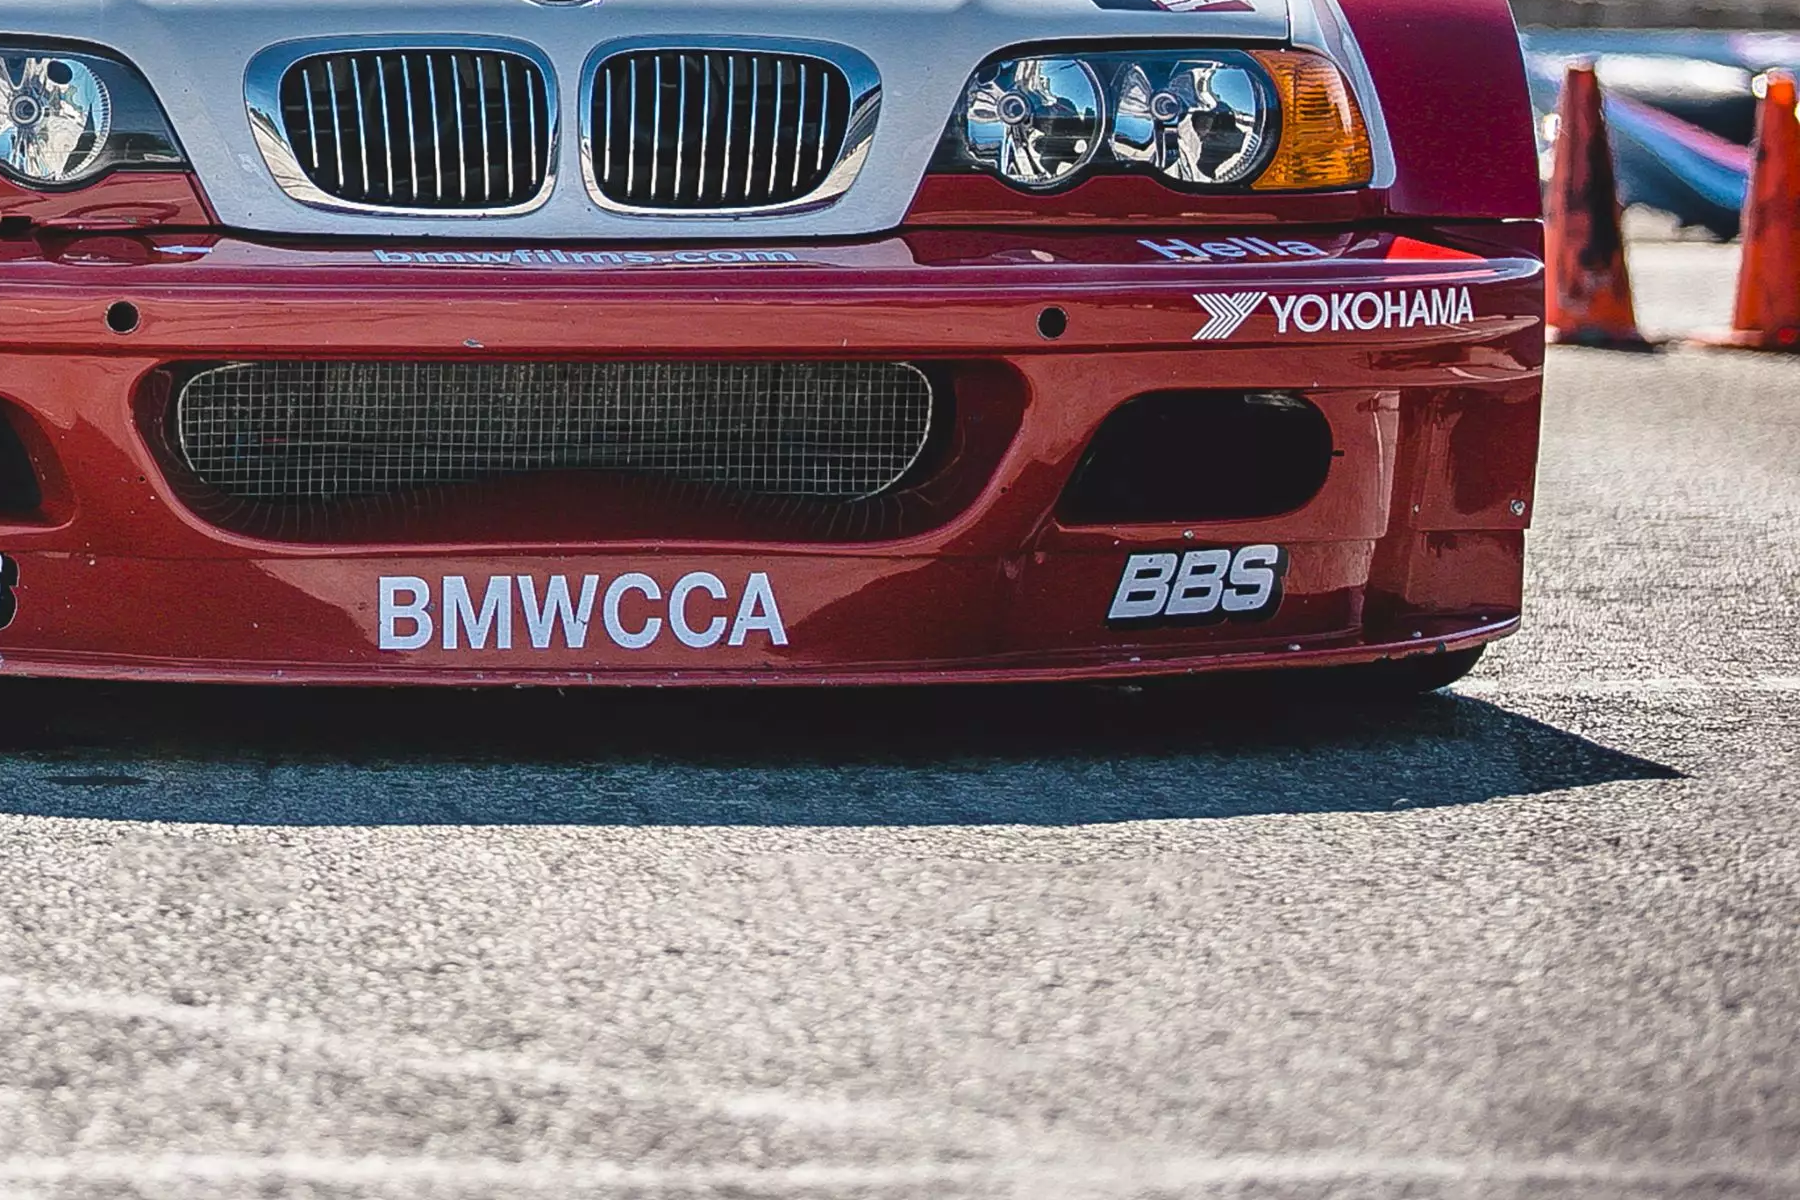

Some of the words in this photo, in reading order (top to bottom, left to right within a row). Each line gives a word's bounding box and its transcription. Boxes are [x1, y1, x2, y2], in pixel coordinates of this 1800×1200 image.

[373, 248, 797, 264] bmwfilms.com
[1137, 236, 1328, 259] Hella
[1268, 287, 1474, 334] YOKOHAMA
[1107, 544, 1278, 619] BBS
[377, 571, 788, 651] BMWCCA
